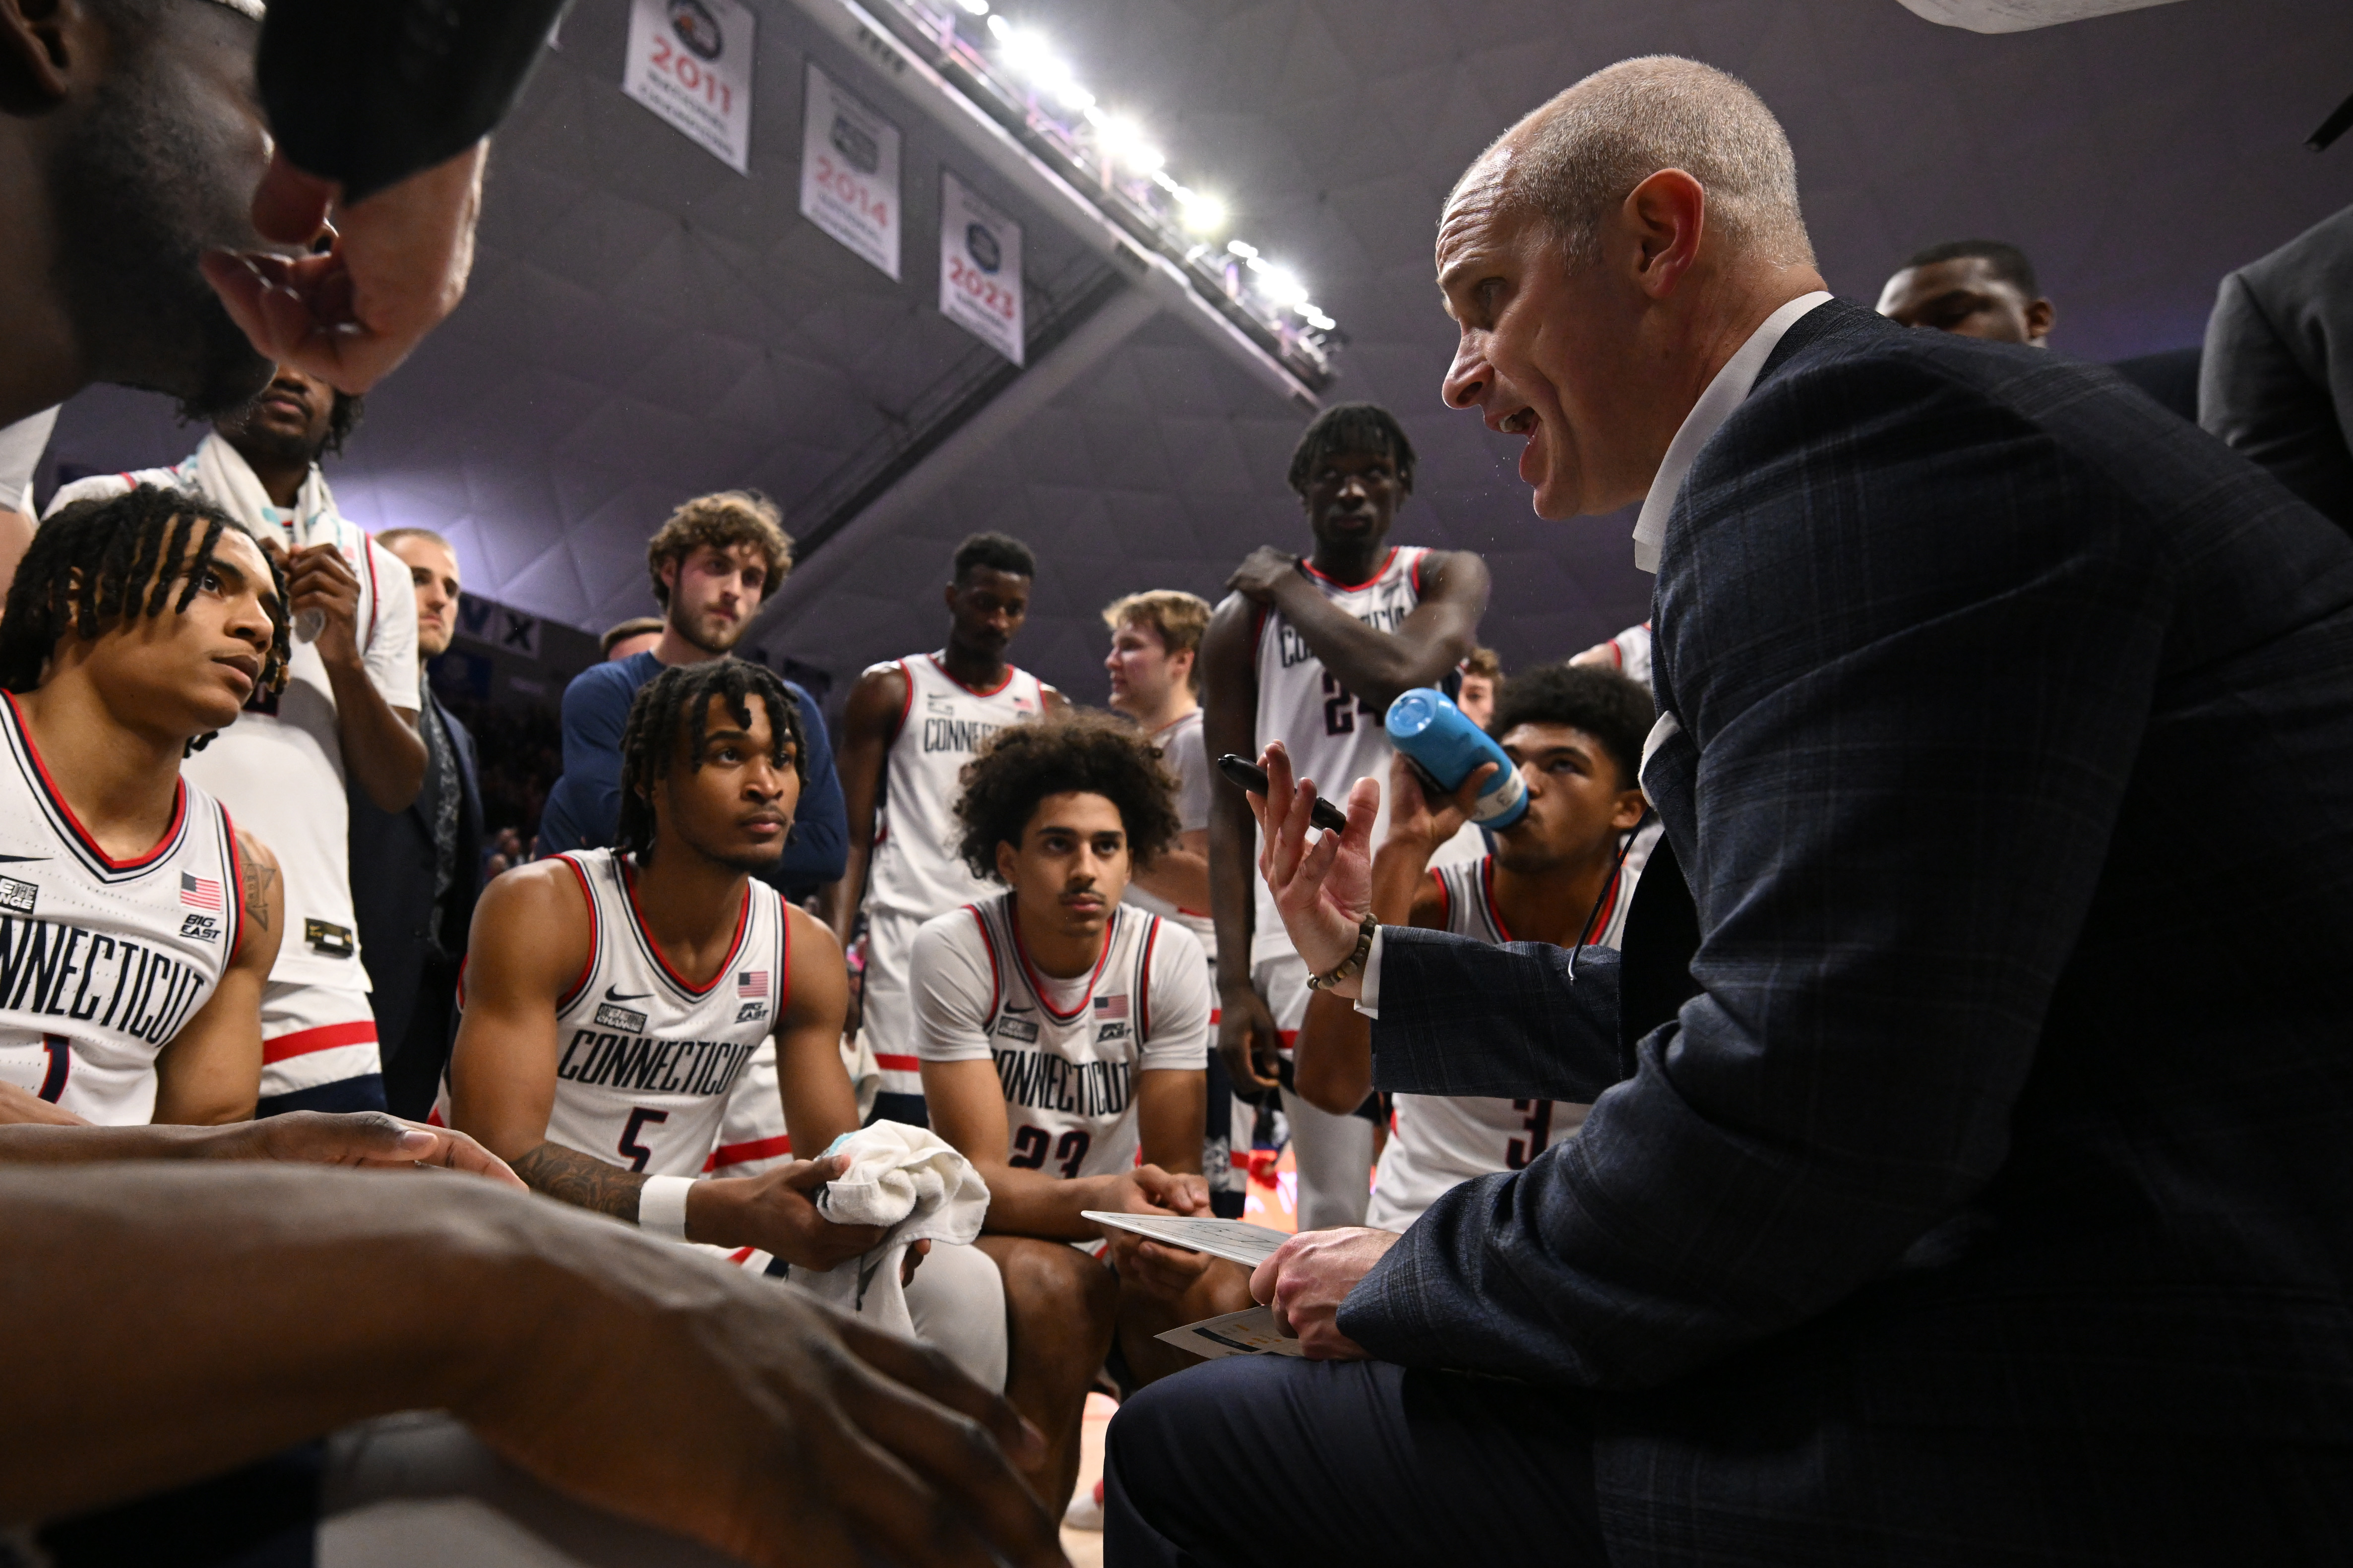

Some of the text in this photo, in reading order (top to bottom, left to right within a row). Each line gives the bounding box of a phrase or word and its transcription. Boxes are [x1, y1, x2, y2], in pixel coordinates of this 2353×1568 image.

[651, 35, 731, 115] 2011
[816, 155, 888, 228] 2014
[949, 255, 1015, 320] 2023
[181, 924, 221, 939] EAST
[185, 914, 217, 928] BIG
[37, 1032, 70, 1104] 1
[557, 1029, 755, 1095] CONNECTICUT
[618, 1107, 670, 1173] 5
[1505, 1098, 1553, 1170] 3
